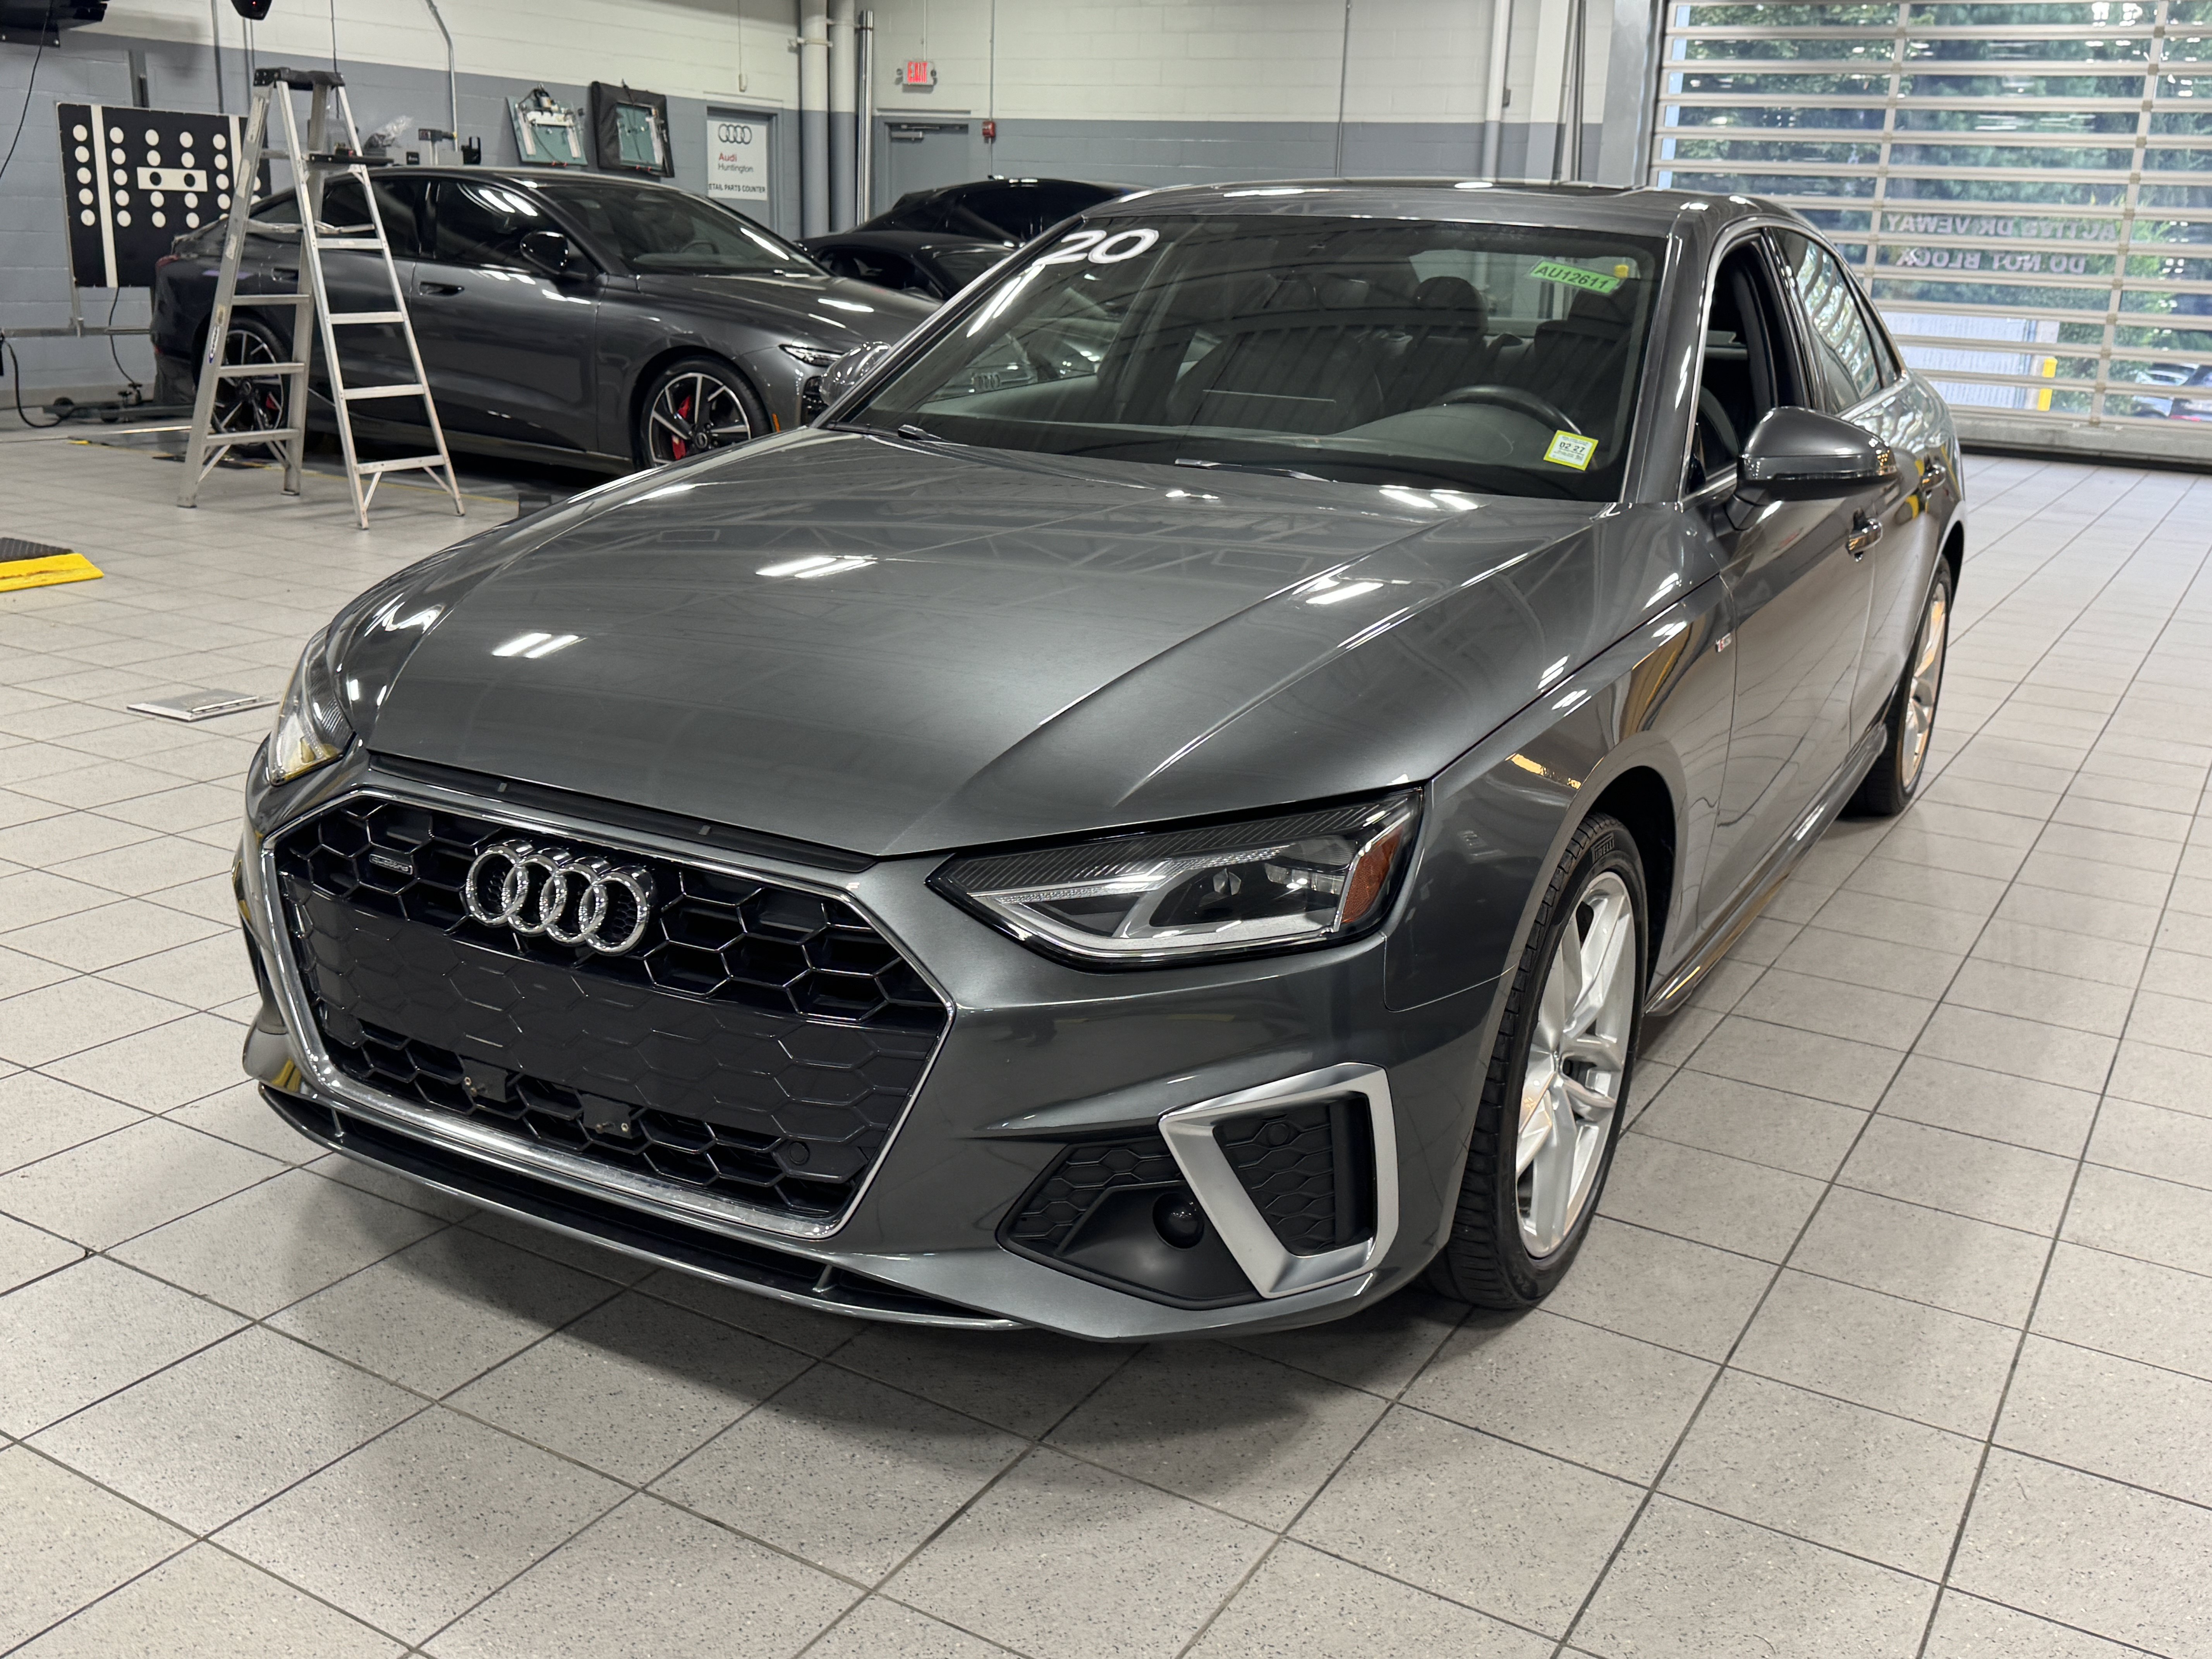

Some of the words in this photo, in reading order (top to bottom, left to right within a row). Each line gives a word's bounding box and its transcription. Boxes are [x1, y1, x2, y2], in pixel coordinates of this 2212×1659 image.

[907, 61, 927, 83] EXIT
[718, 163, 754, 173] Huntington
[719, 153, 737, 162] Audi
[1032, 228, 1159, 266] 20
[1534, 266, 1609, 289] AU12611
